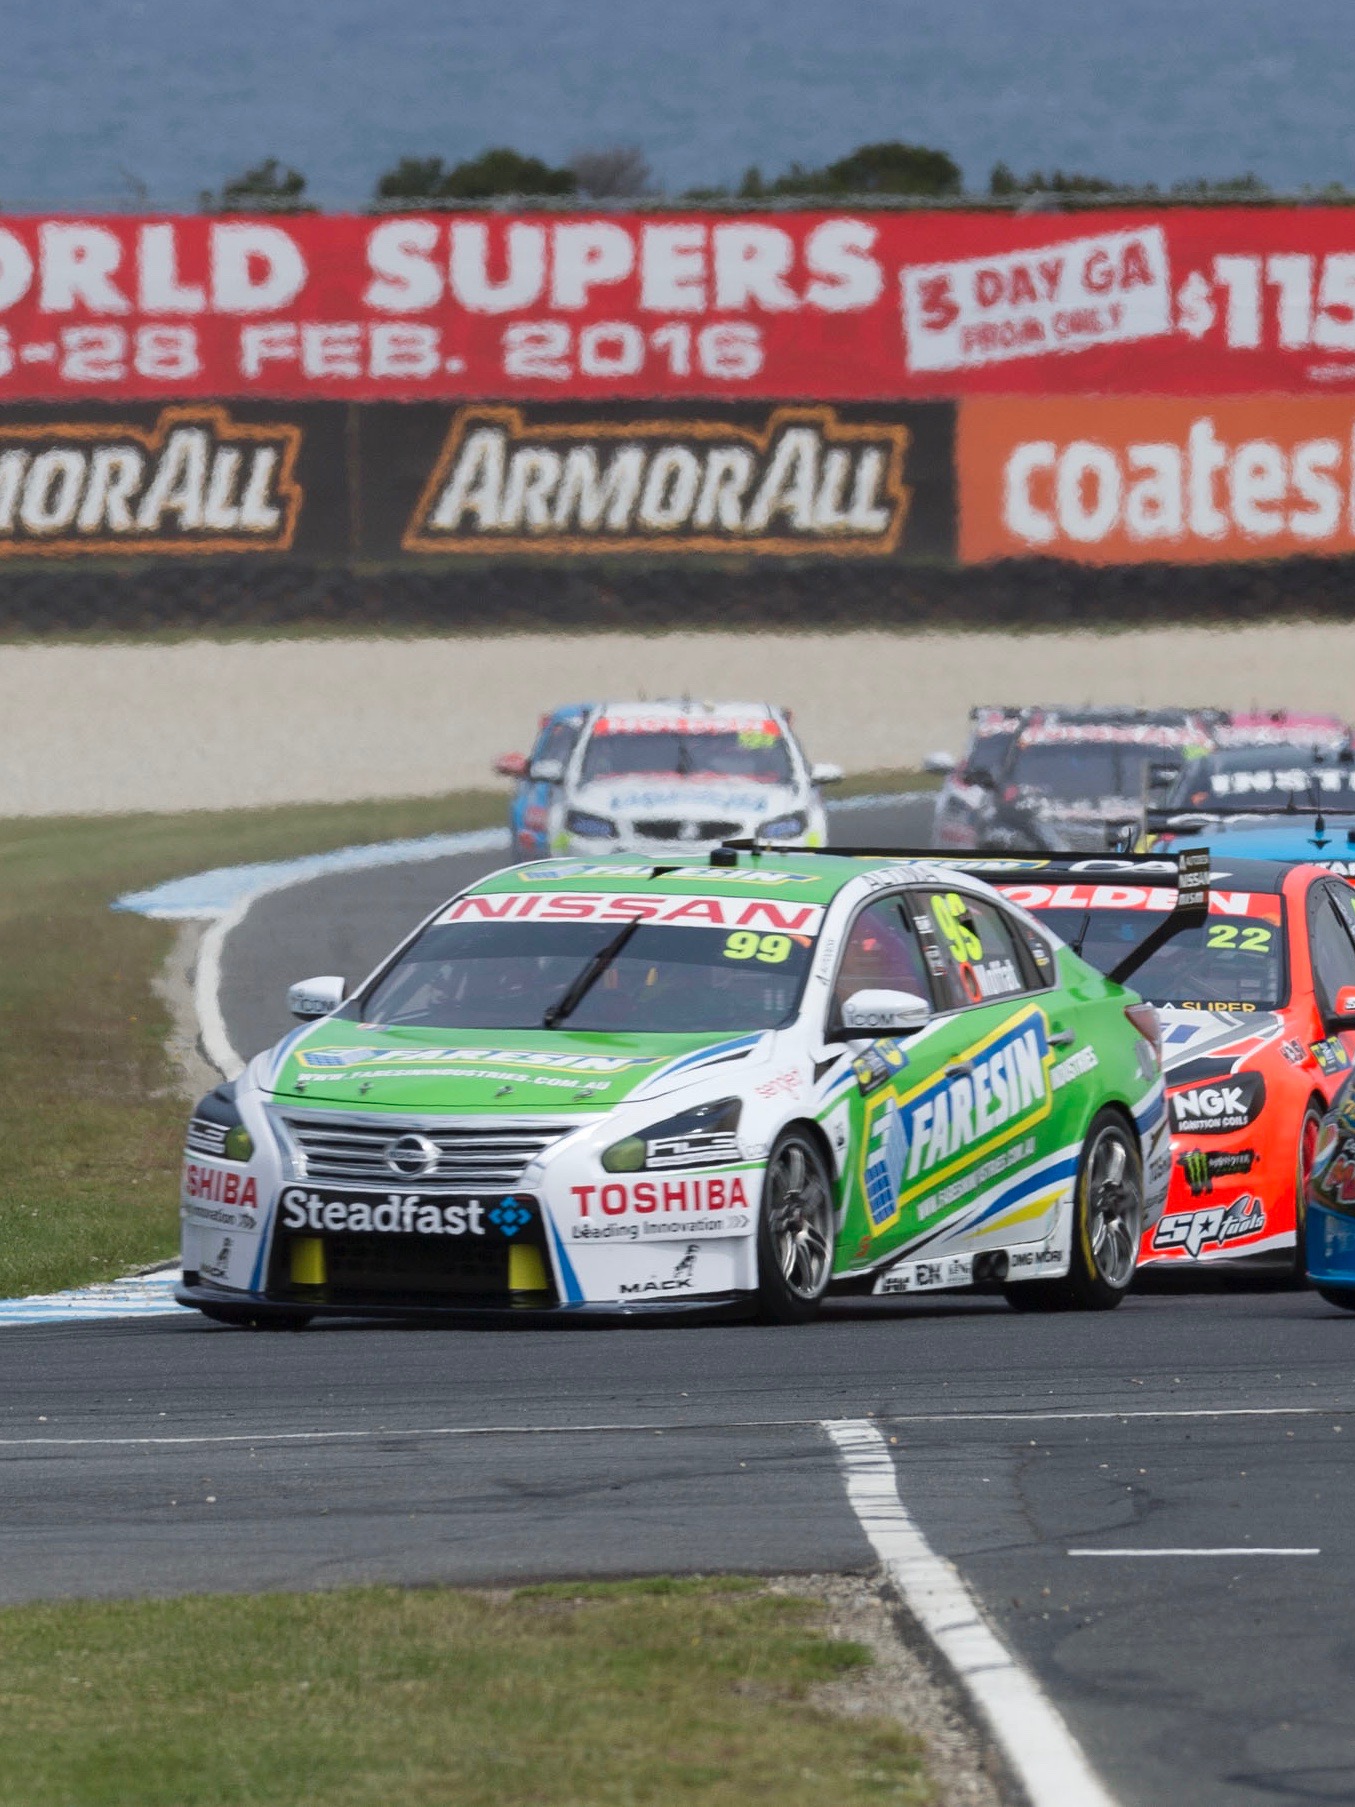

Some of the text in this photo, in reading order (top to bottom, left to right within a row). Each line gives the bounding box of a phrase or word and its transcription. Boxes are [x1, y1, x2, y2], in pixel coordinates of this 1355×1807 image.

[364, 218, 883, 315] SUPERS
[973, 249, 1064, 310] DAY
[0, 320, 765, 380] -28 FEB. 2016
[0, 426, 285, 534] ORALL
[450, 895, 814, 930] NISSAN
[722, 930, 793, 964] 99
[1206, 924, 1272, 953] 22
[375, 1048, 633, 1071] FARESIN
[907, 1029, 1046, 1181] FARESIN
[1172, 1087, 1248, 1121] NGK
[1178, 1118, 1221, 1132] IGNITION
[282, 1190, 486, 1237] Steadfast
[570, 1177, 749, 1217] TOSHIBA
[571, 1217, 723, 1240] Leading Innovation
[619, 1277, 695, 1294] MACK
